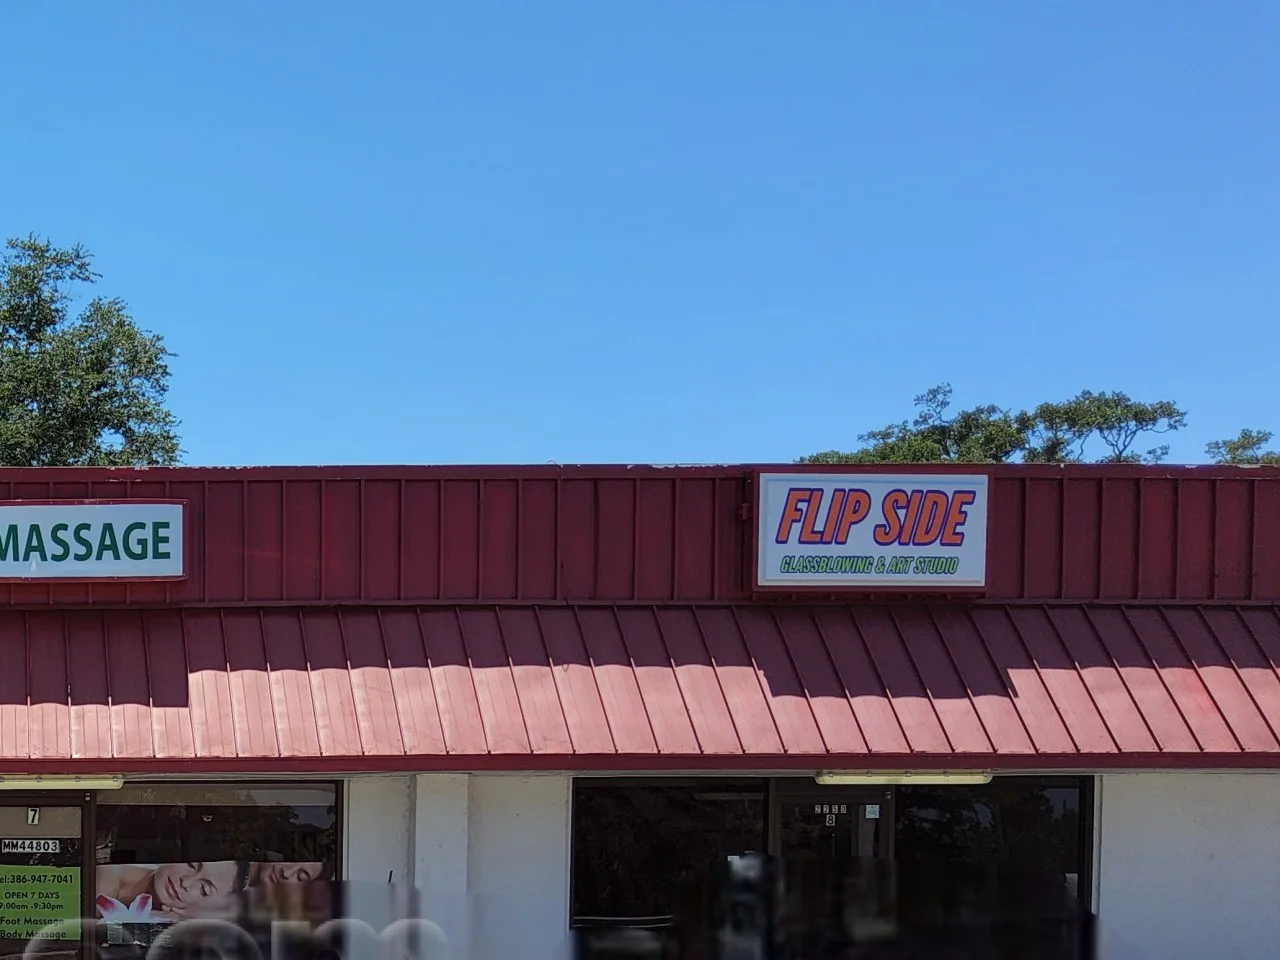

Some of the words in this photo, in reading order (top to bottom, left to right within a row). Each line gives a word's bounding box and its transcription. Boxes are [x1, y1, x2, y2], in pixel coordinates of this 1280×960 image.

[775, 488, 871, 545] FLIP
[873, 489, 976, 546] SIDE
[780, 555, 874, 574] GLASSBLOWING
[875, 556, 888, 574] &
[887, 556, 913, 575] ART
[913, 556, 959, 575] STUDIO
[29, 808, 38, 824] 7
[827, 815, 835, 825] 8
[2, 841, 58, 851] MM44803
[0, 917, 20, 925] Foot
[23, 917, 64, 927] Massage
[0, 930, 22, 939] Body
[25, 930, 66, 939] Massage
